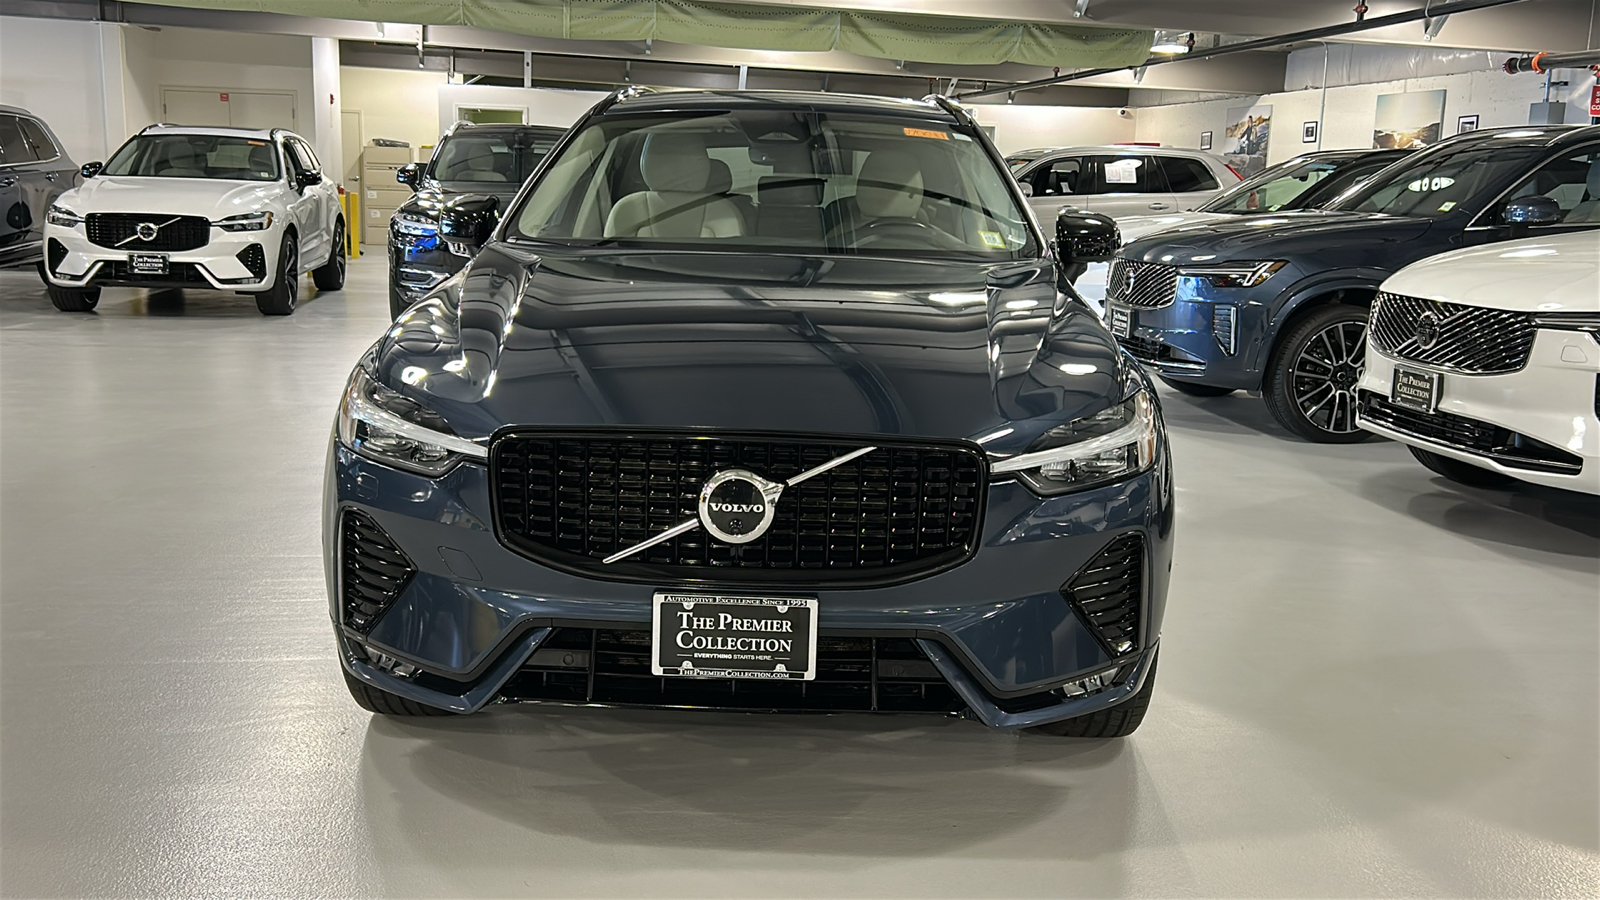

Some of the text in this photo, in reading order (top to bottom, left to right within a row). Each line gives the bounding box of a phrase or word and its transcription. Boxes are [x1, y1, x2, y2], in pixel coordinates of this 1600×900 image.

[1397, 383, 1430, 399] COLLECTION
[709, 502, 764, 513] VOLVO
[665, 595, 807, 607] AUTOMOTIVE EXCELLENCE SINCE 1995
[677, 611, 793, 633] THE PREMIER
[676, 630, 793, 653] COLLECTION
[694, 652, 732, 660] EVERYTHING
